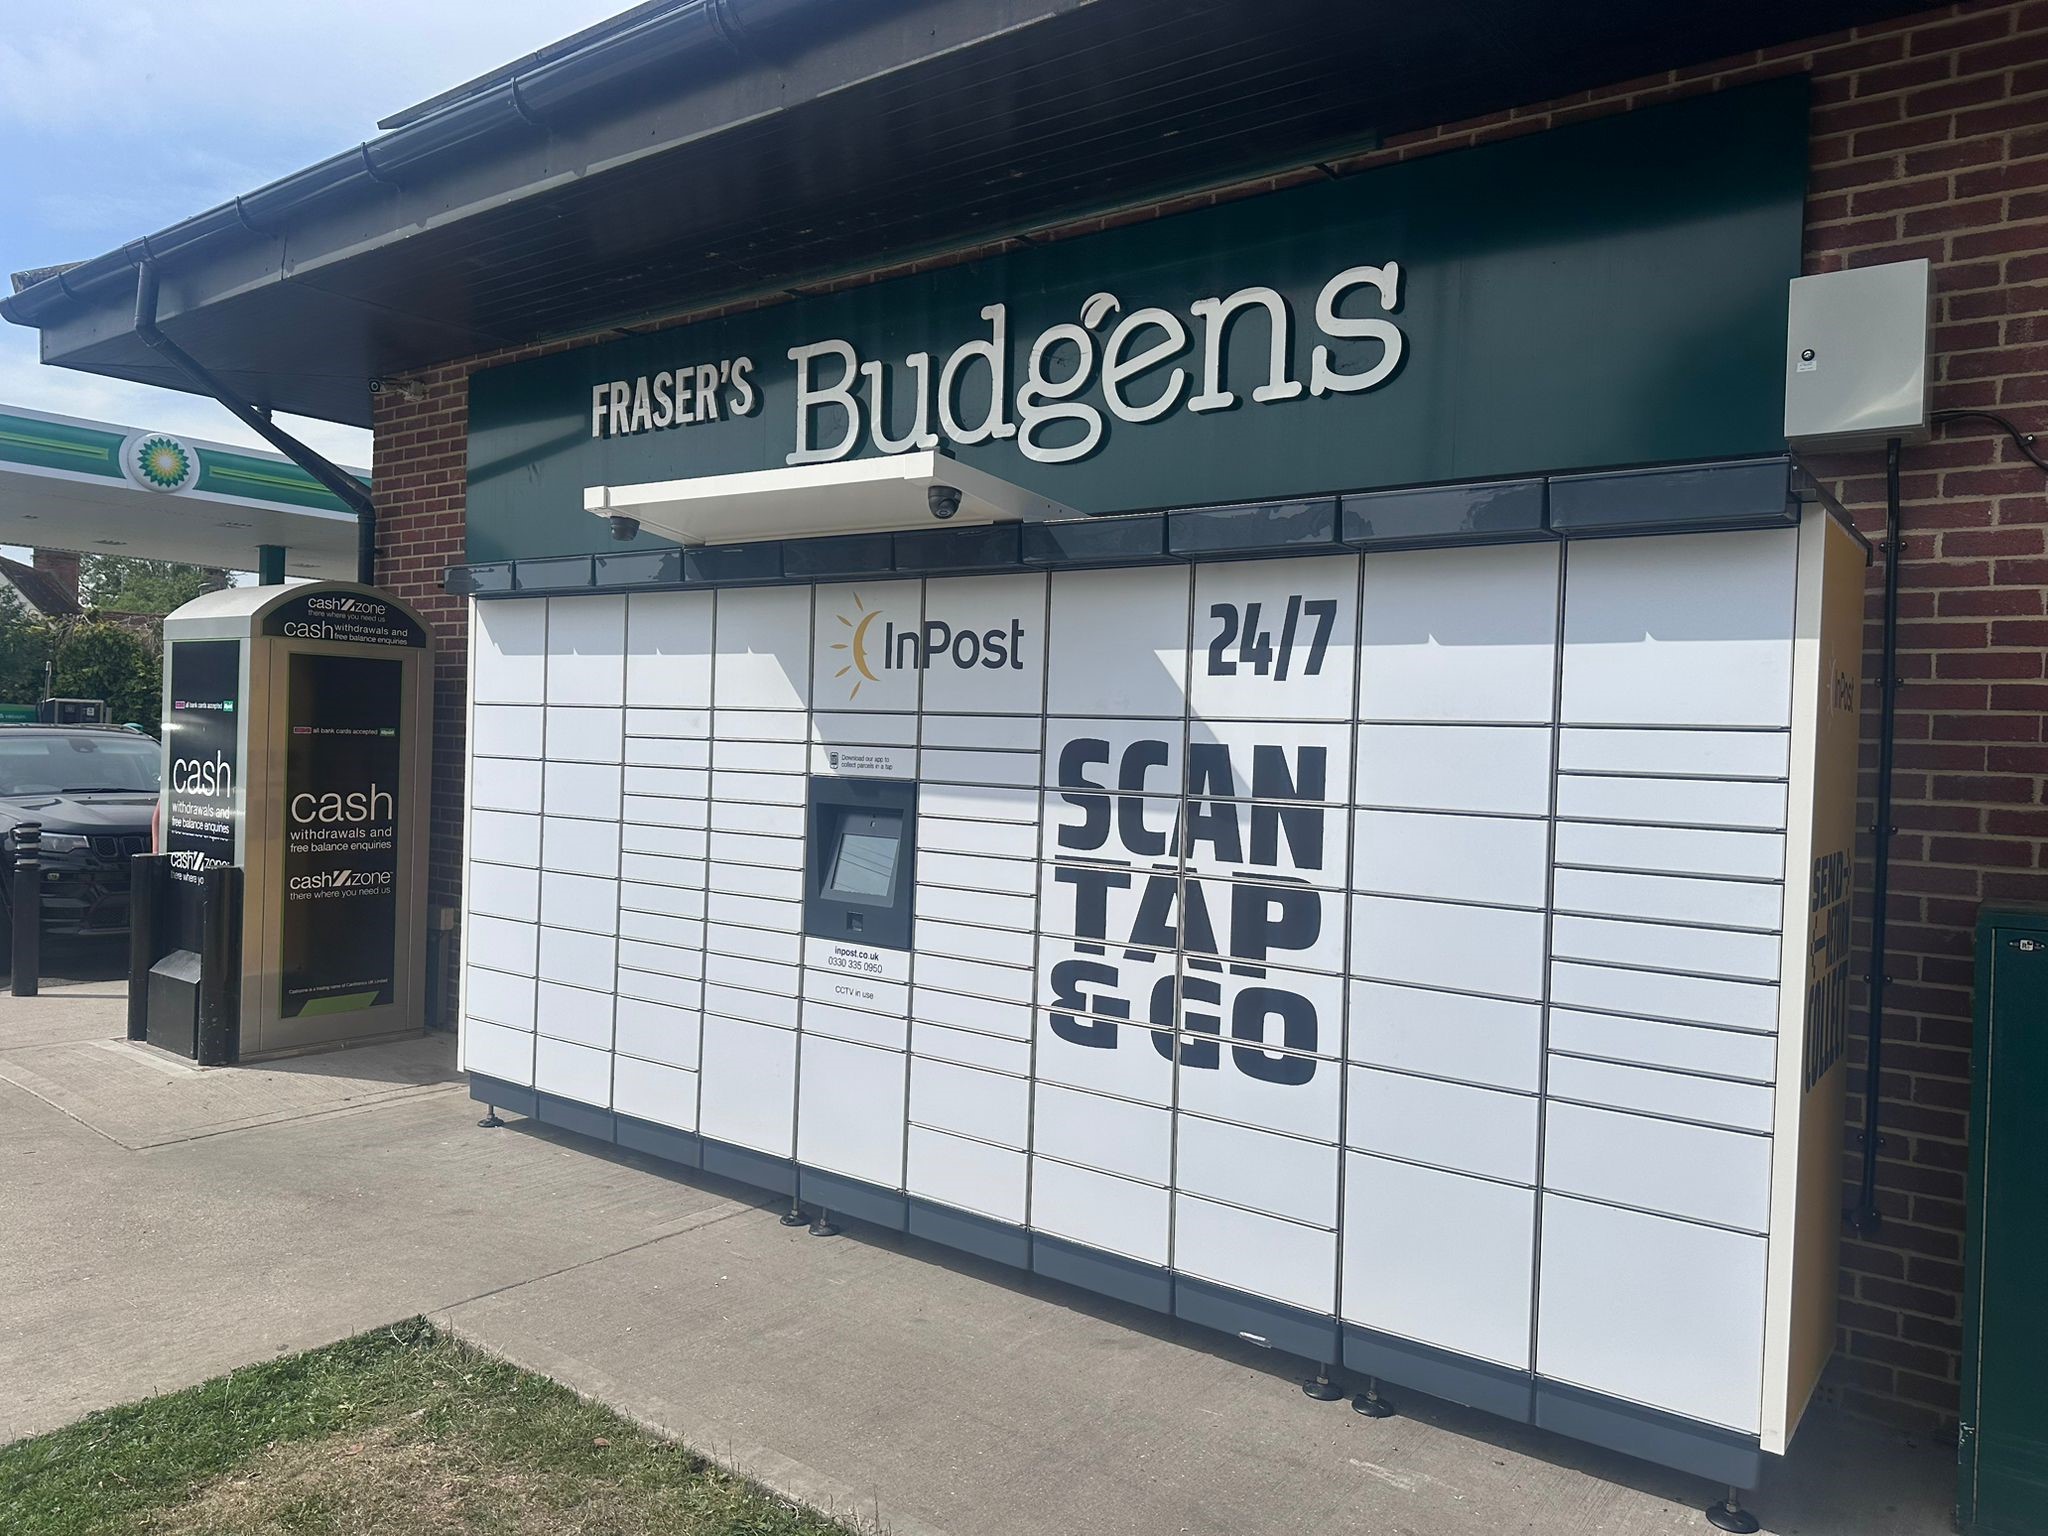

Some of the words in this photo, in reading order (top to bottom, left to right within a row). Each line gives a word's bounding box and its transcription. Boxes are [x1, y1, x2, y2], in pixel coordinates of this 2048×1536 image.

[592, 356, 754, 438] FRASER'S
[786, 261, 1402, 465] Budgens
[308, 609, 325, 617] there
[326, 611, 346, 619] where
[347, 613, 359, 621] you
[361, 614, 377, 622] need
[284, 621, 334, 639] cash
[334, 623, 389, 635] withdrawals
[392, 628, 408, 637] and
[334, 633, 348, 641] free
[349, 634, 376, 643] balance
[378, 636, 408, 645] enquiries
[1206, 595, 1338, 682] 24/7
[884, 618, 1025, 671] InPost
[841, 754, 865, 762] Download
[173, 750, 231, 798] cash
[172, 801, 214, 818] withdrawals
[215, 806, 230, 820] and
[291, 783, 392, 823] cash
[1058, 738, 1327, 870] SCAN
[172, 816, 182, 828] free
[183, 818, 204, 831] balance
[204, 821, 230, 834] enquiries
[290, 826, 366, 841] withdrawals
[370, 826, 392, 838] and
[290, 843, 309, 853] free
[311, 841, 349, 852] balance
[350, 840, 392, 852] enquiries
[197, 876, 205, 886] yo
[1812, 851, 1843, 913] SEND
[290, 891, 312, 901] there
[314, 889, 340, 899] where
[342, 888, 357, 898] you
[359, 886, 379, 896] need
[381, 886, 391, 894] us
[1054, 854, 1322, 979] TAP
[834, 946, 879, 961] inpost.co.uk
[828, 956, 847, 968] 0330
[848, 959, 862, 970] 335
[864, 962, 883, 974] 0950
[835, 985, 855, 995] CCTV
[855, 989, 861, 997] in
[1050, 960, 1131, 1049] &
[1150, 974, 1318, 1085] GO
